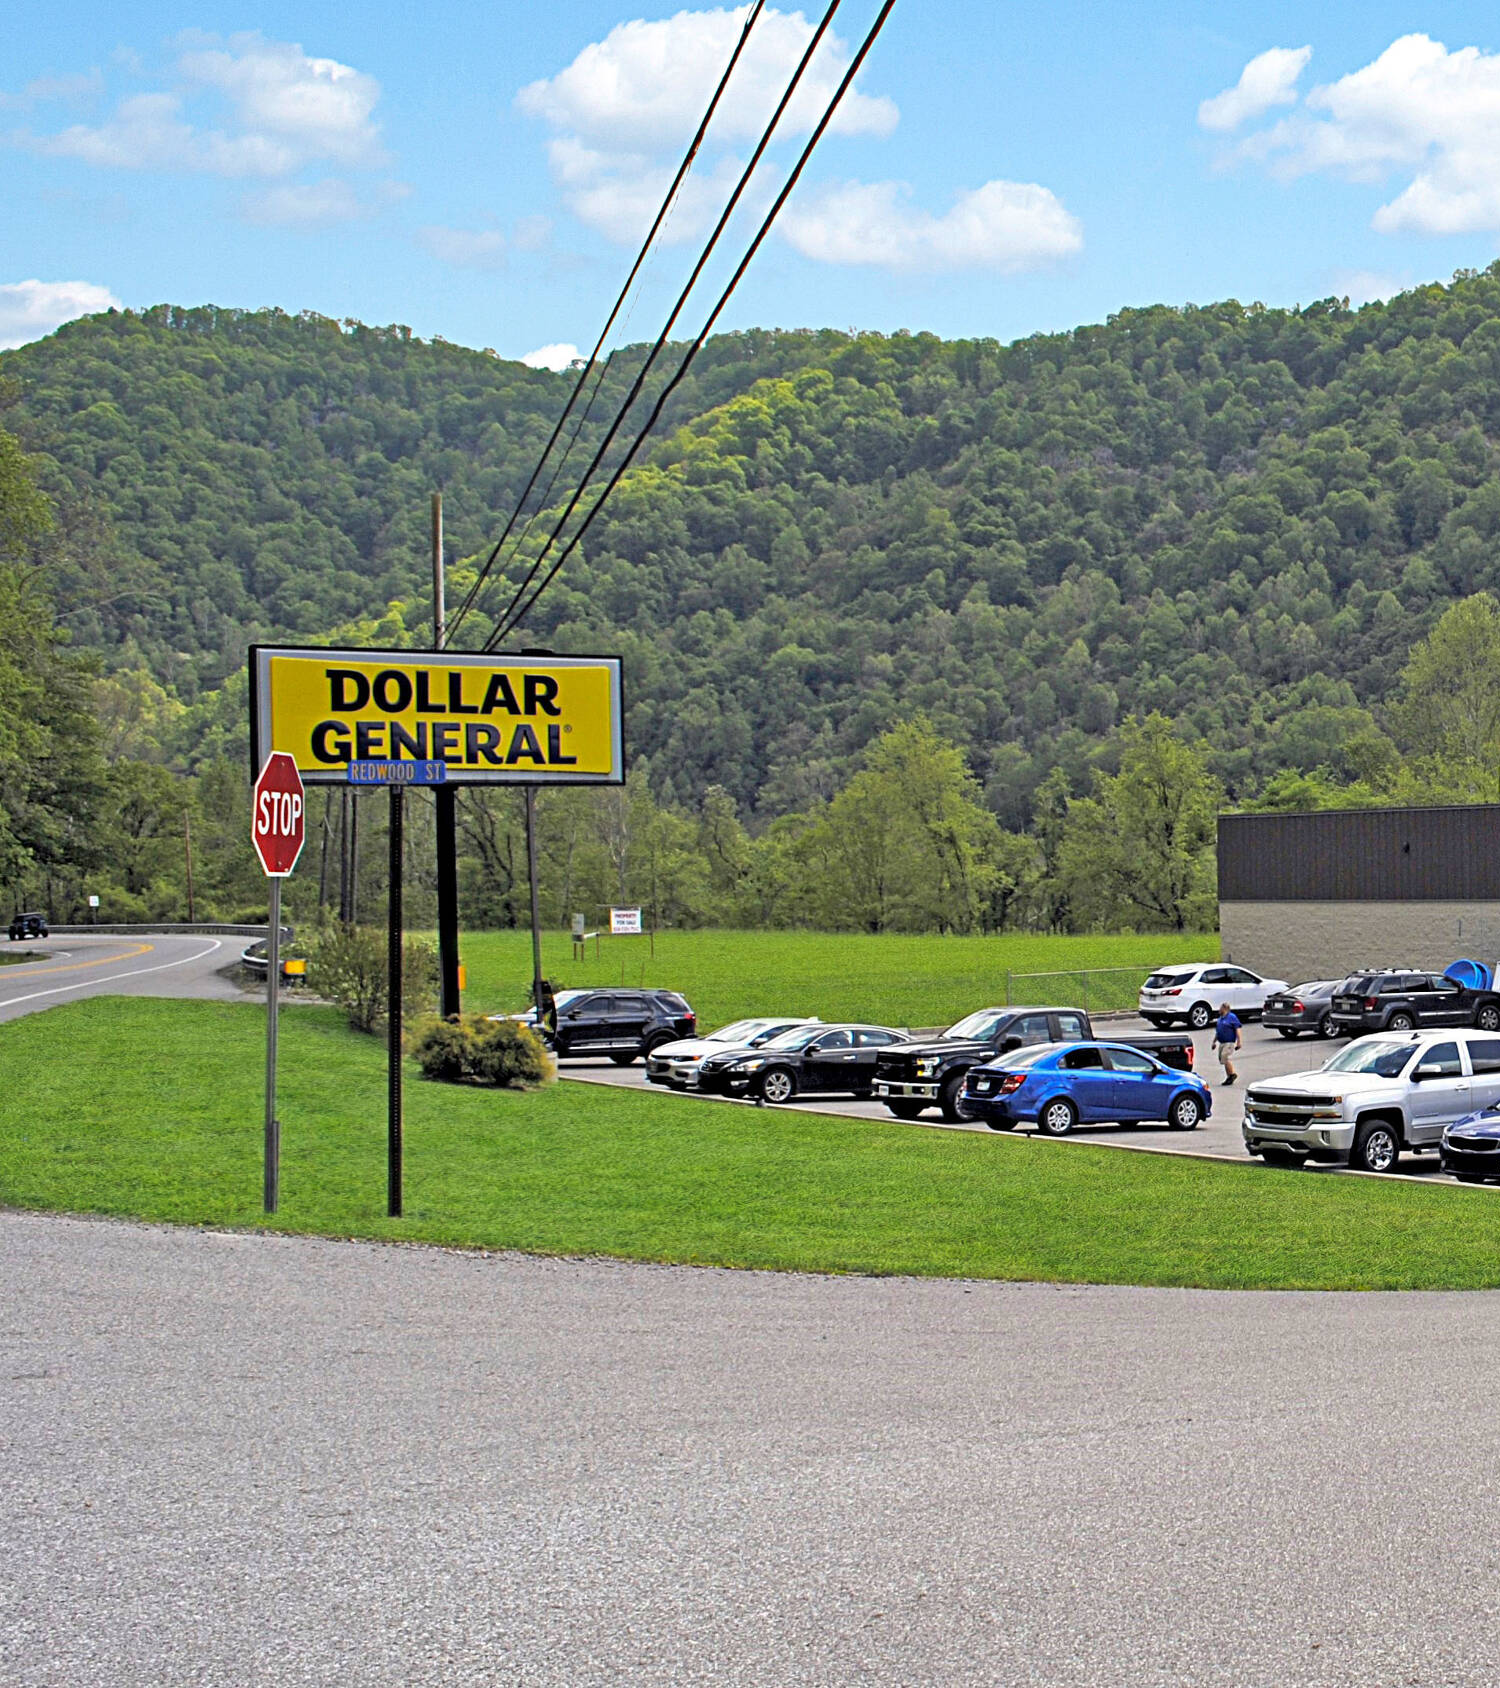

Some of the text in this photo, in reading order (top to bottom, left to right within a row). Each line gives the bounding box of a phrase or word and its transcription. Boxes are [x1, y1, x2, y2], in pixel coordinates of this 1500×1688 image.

[326, 669, 561, 716] DOLLAR
[311, 720, 577, 765] GENERAL
[351, 763, 441, 780] REDWOOD ST
[257, 790, 302, 836] STOP
